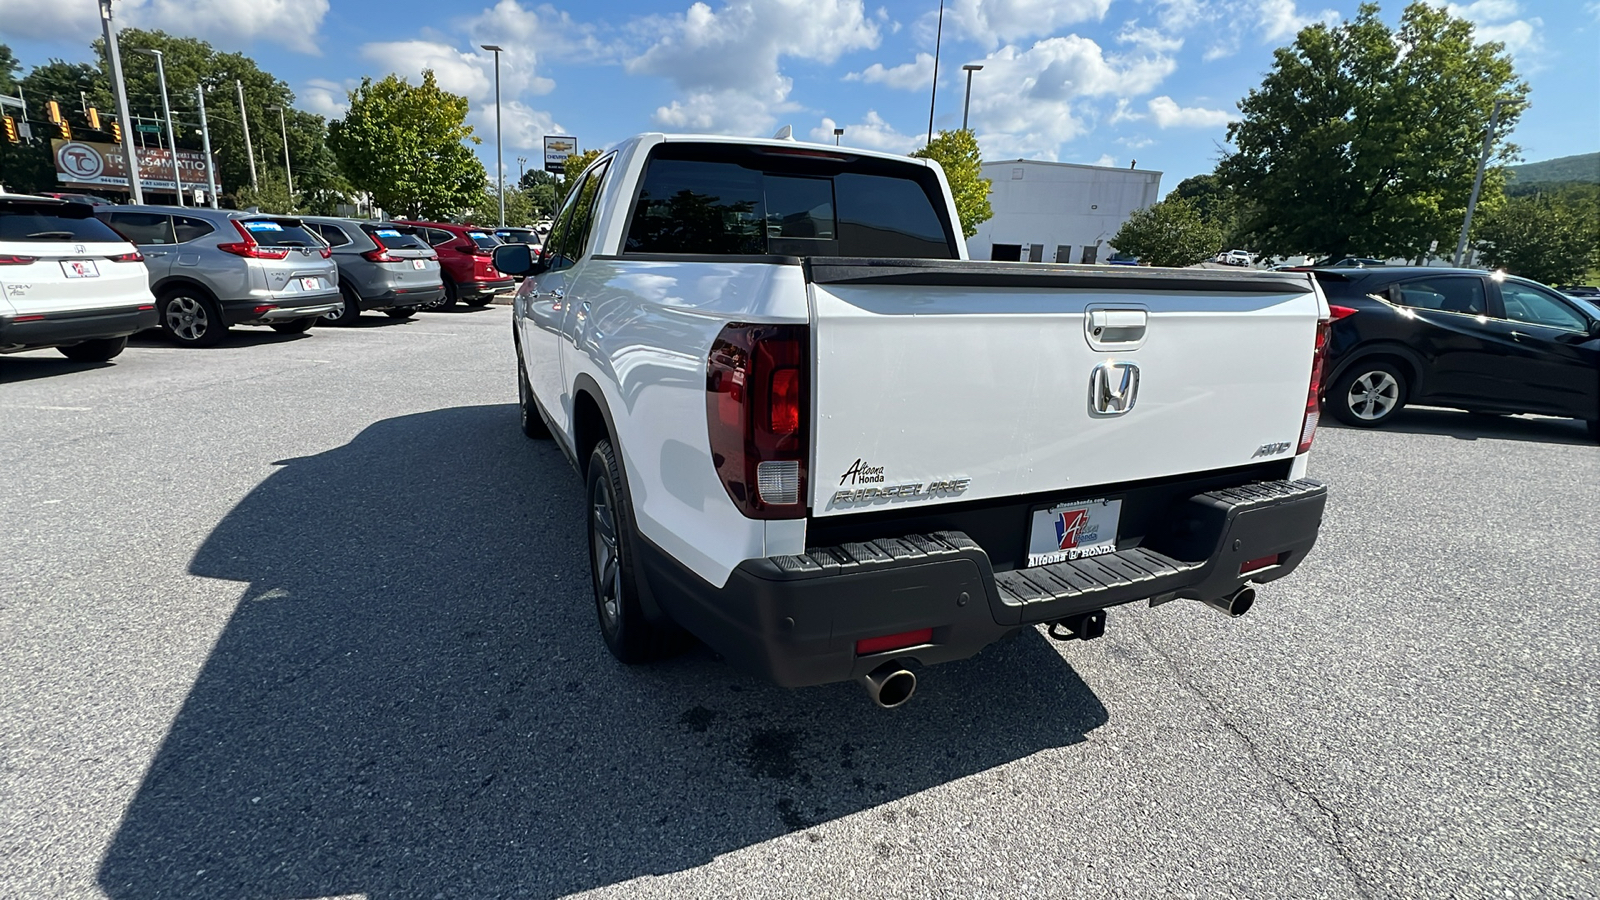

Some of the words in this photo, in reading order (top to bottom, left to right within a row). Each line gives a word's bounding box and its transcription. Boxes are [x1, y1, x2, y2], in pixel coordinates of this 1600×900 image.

[1253, 442, 1291, 457] AWD
[840, 457, 884, 486] Altoona
[858, 475, 885, 485] Honda
[831, 478, 971, 505] RIDGELINE
[1028, 553, 1067, 568] Altoona
[1081, 544, 1117, 558] HONDA
